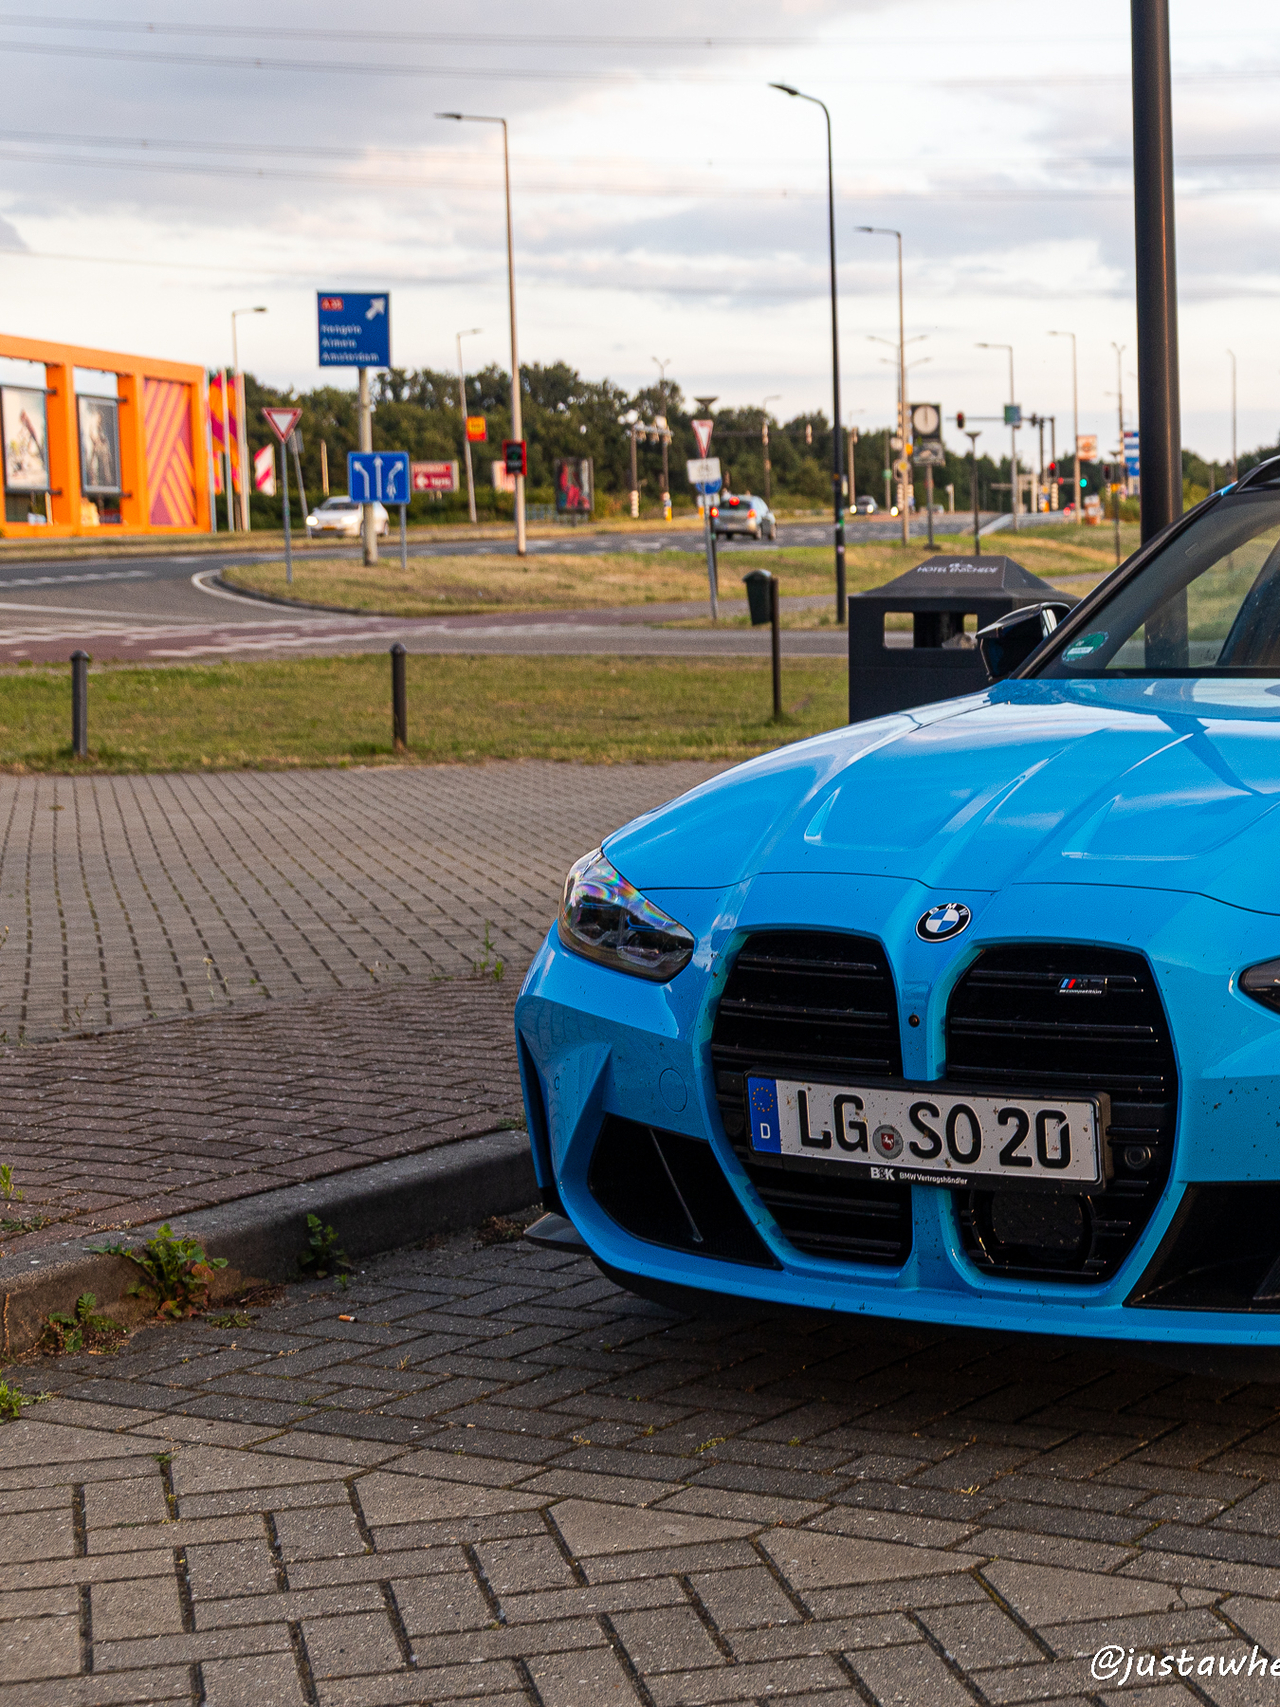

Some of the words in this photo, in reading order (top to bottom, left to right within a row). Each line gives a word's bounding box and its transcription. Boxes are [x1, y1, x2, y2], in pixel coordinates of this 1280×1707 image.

[928, 903, 969, 917] BMW
[797, 1089, 869, 1153] LG
[759, 1122, 771, 1139] D
[870, 1166, 895, 1181] B&K
[899, 1172, 916, 1181] BMW
